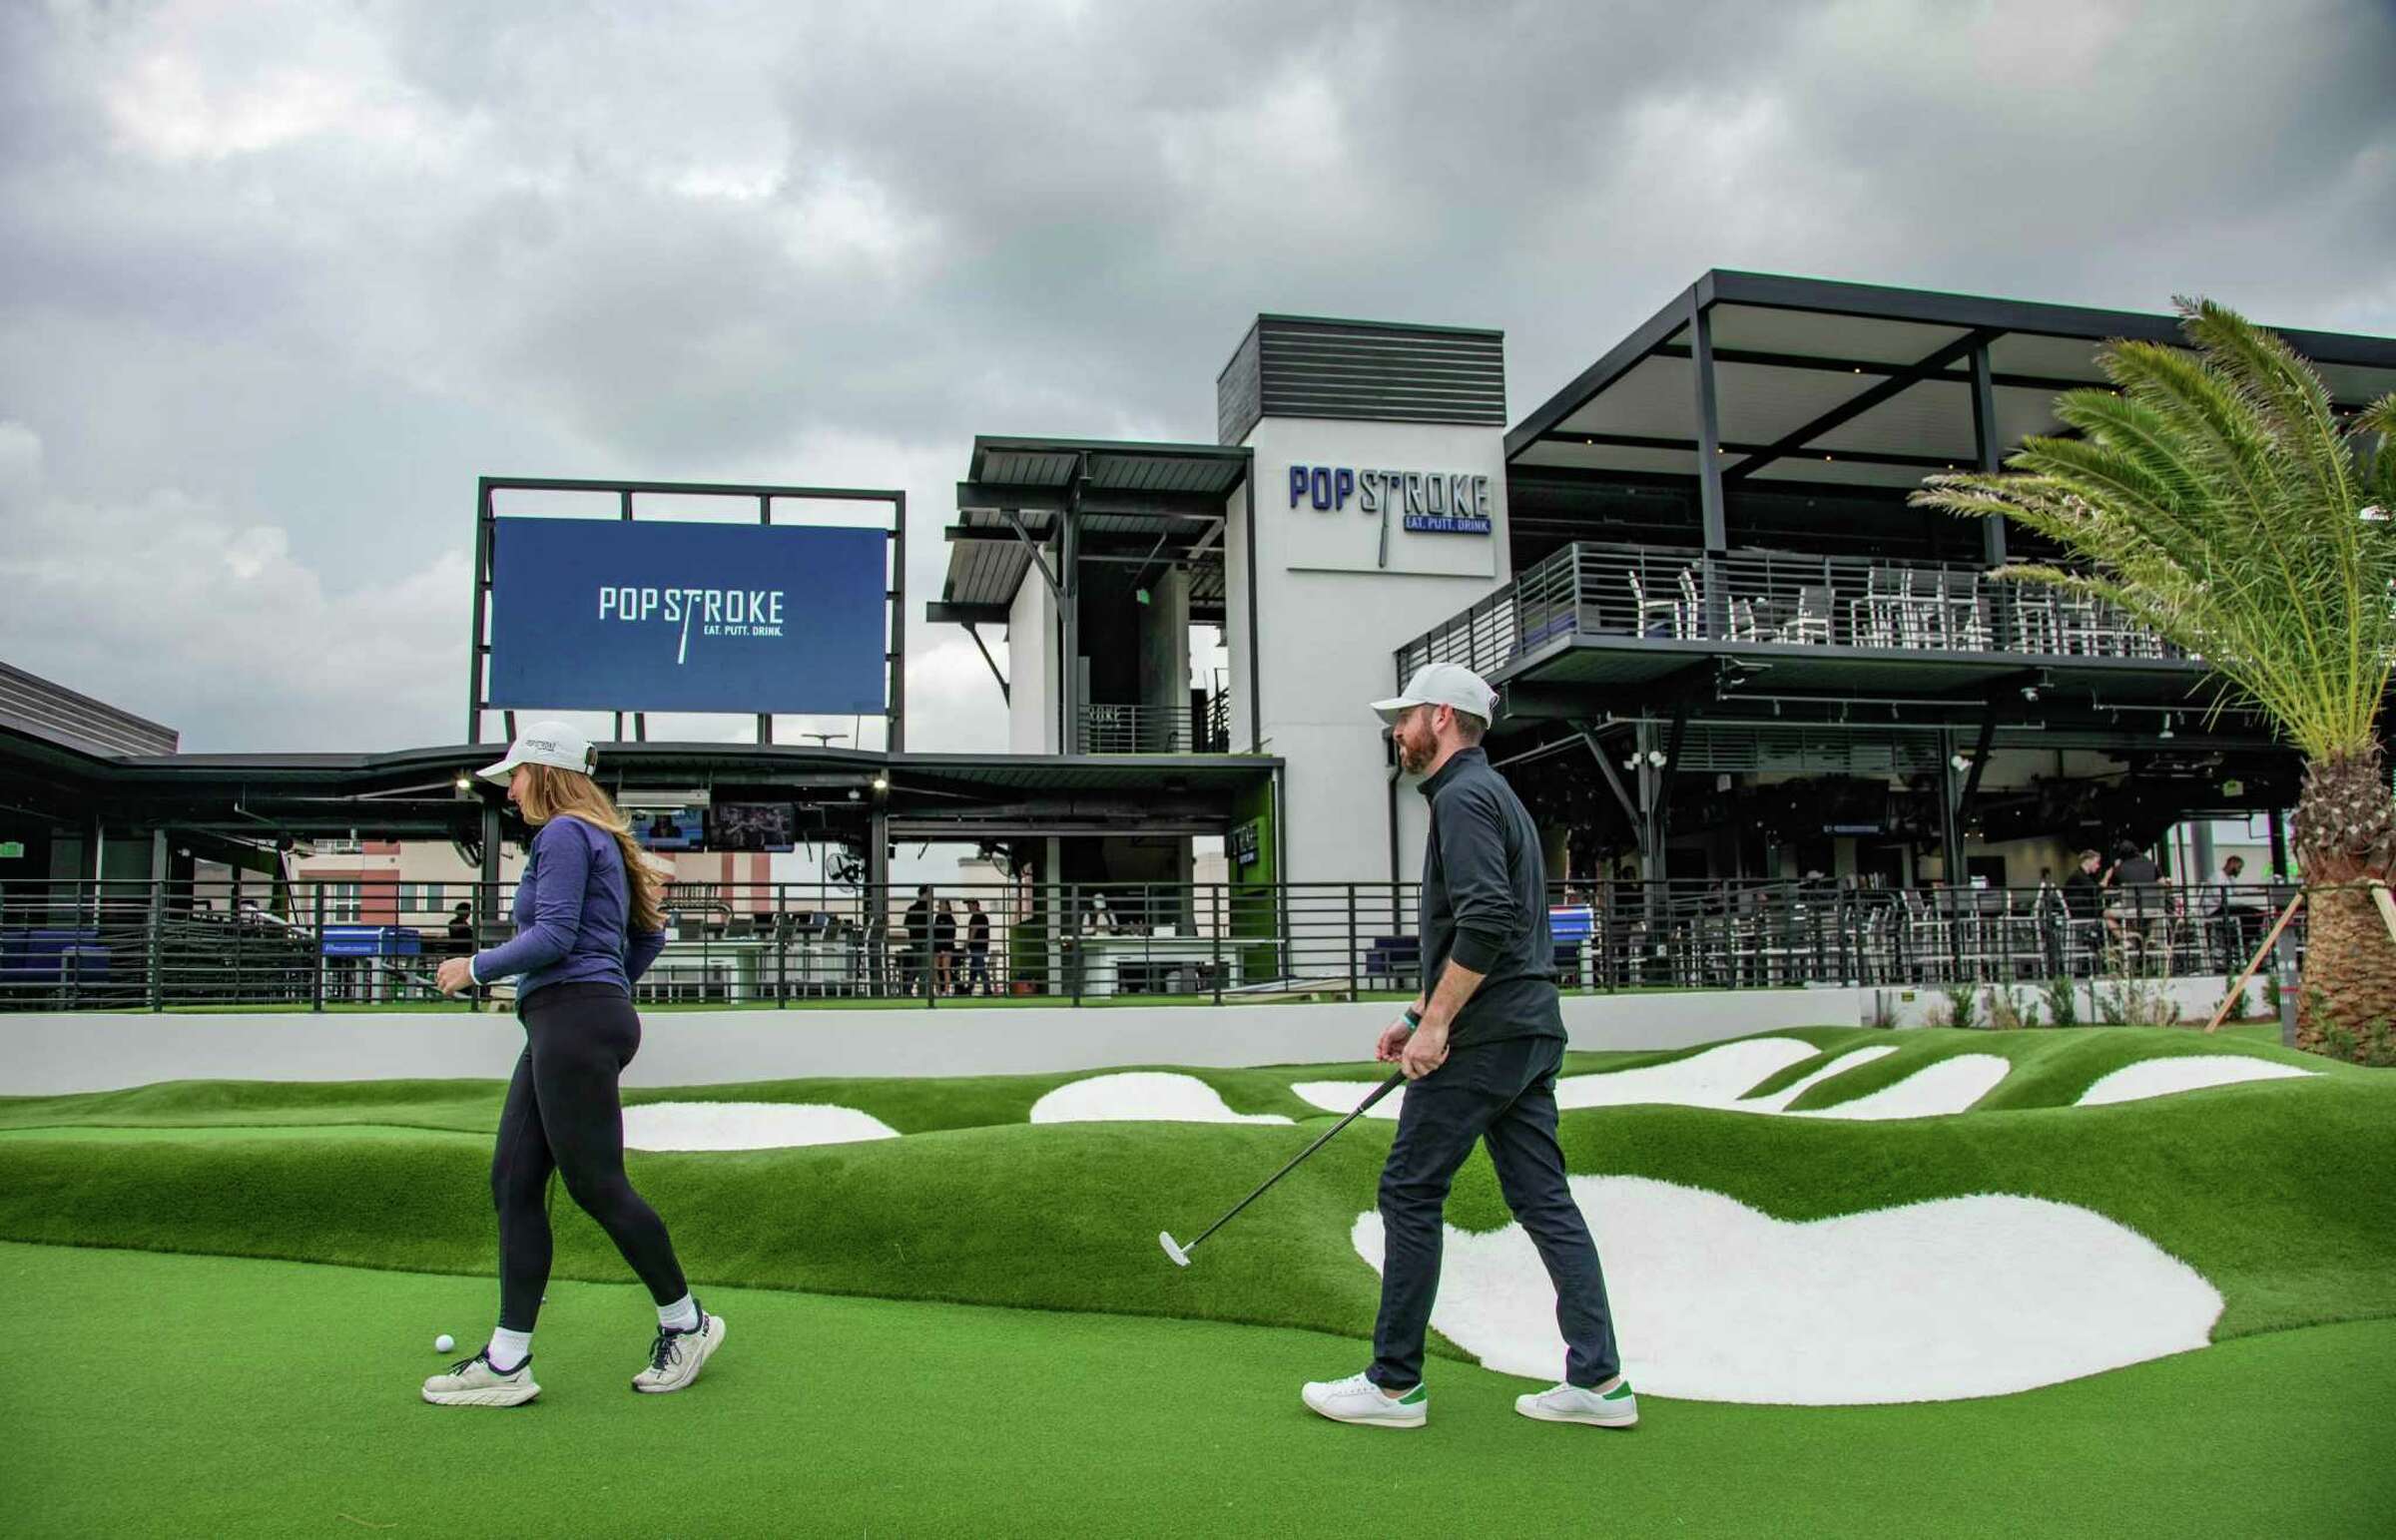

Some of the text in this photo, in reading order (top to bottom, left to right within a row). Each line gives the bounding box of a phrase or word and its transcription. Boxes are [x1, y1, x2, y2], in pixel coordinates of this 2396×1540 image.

[1406, 516, 1427, 529] EAT.
[1428, 518, 1455, 530] PUTT.
[704, 625, 784, 637] EAT. PUTT. DRINK.
